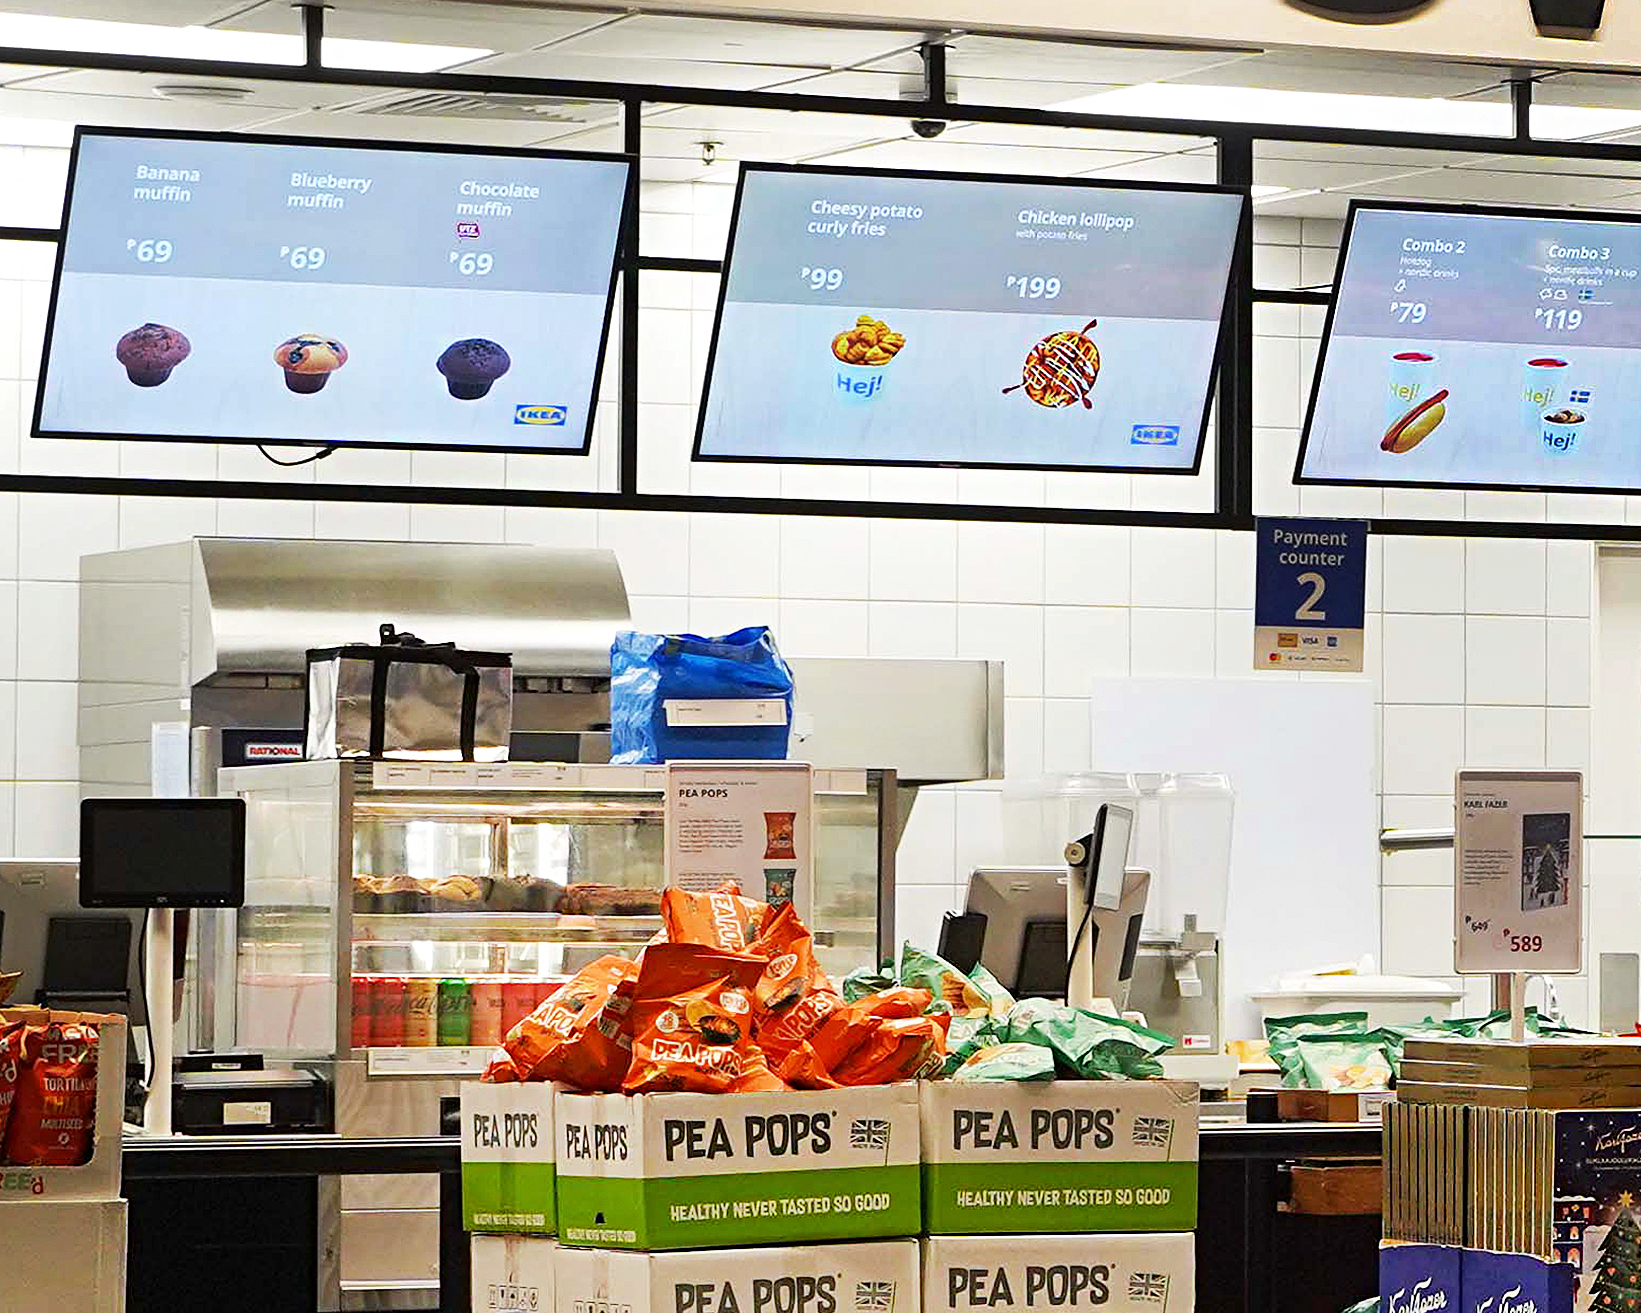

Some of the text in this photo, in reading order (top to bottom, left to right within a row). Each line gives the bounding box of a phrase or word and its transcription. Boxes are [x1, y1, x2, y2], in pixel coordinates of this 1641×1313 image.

[136, 165, 200, 183] Banana
[290, 173, 372, 194] Blueberry
[133, 184, 191, 202] muffin
[287, 191, 344, 209] muffin
[460, 180, 540, 200] Chocolate
[456, 199, 513, 217] muffin
[811, 200, 923, 221] Cheesy potato
[807, 218, 886, 238] curly fries
[1018, 209, 1134, 231] Chicken lollipop
[1402, 238, 1465, 254] Combo 2
[1548, 244, 1610, 260] Combo 3
[836, 373, 883, 398] Hej!
[517, 406, 566, 423] IKEA
[1543, 430, 1576, 450] Hej!
[1274, 529, 1347, 548] Payment
[1279, 552, 1345, 566] counter
[1295, 572, 1326, 620] 2
[249, 745, 300, 757] RATIONAL
[679, 789, 728, 798] PEA POPS
[473, 1113, 538, 1149] PEA POPS
[664, 1112, 832, 1161] PEA POPS
[953, 1108, 1114, 1150] PEA POPS
[566, 1123, 629, 1162] PEA POPS
[670, 1192, 891, 1222] HEALTHY NEVER TASTED SO GOOD
[957, 1188, 1170, 1207] HEALTHY NEVER TASTED SO GOOD
[949, 1264, 1110, 1308] PEA POPS
